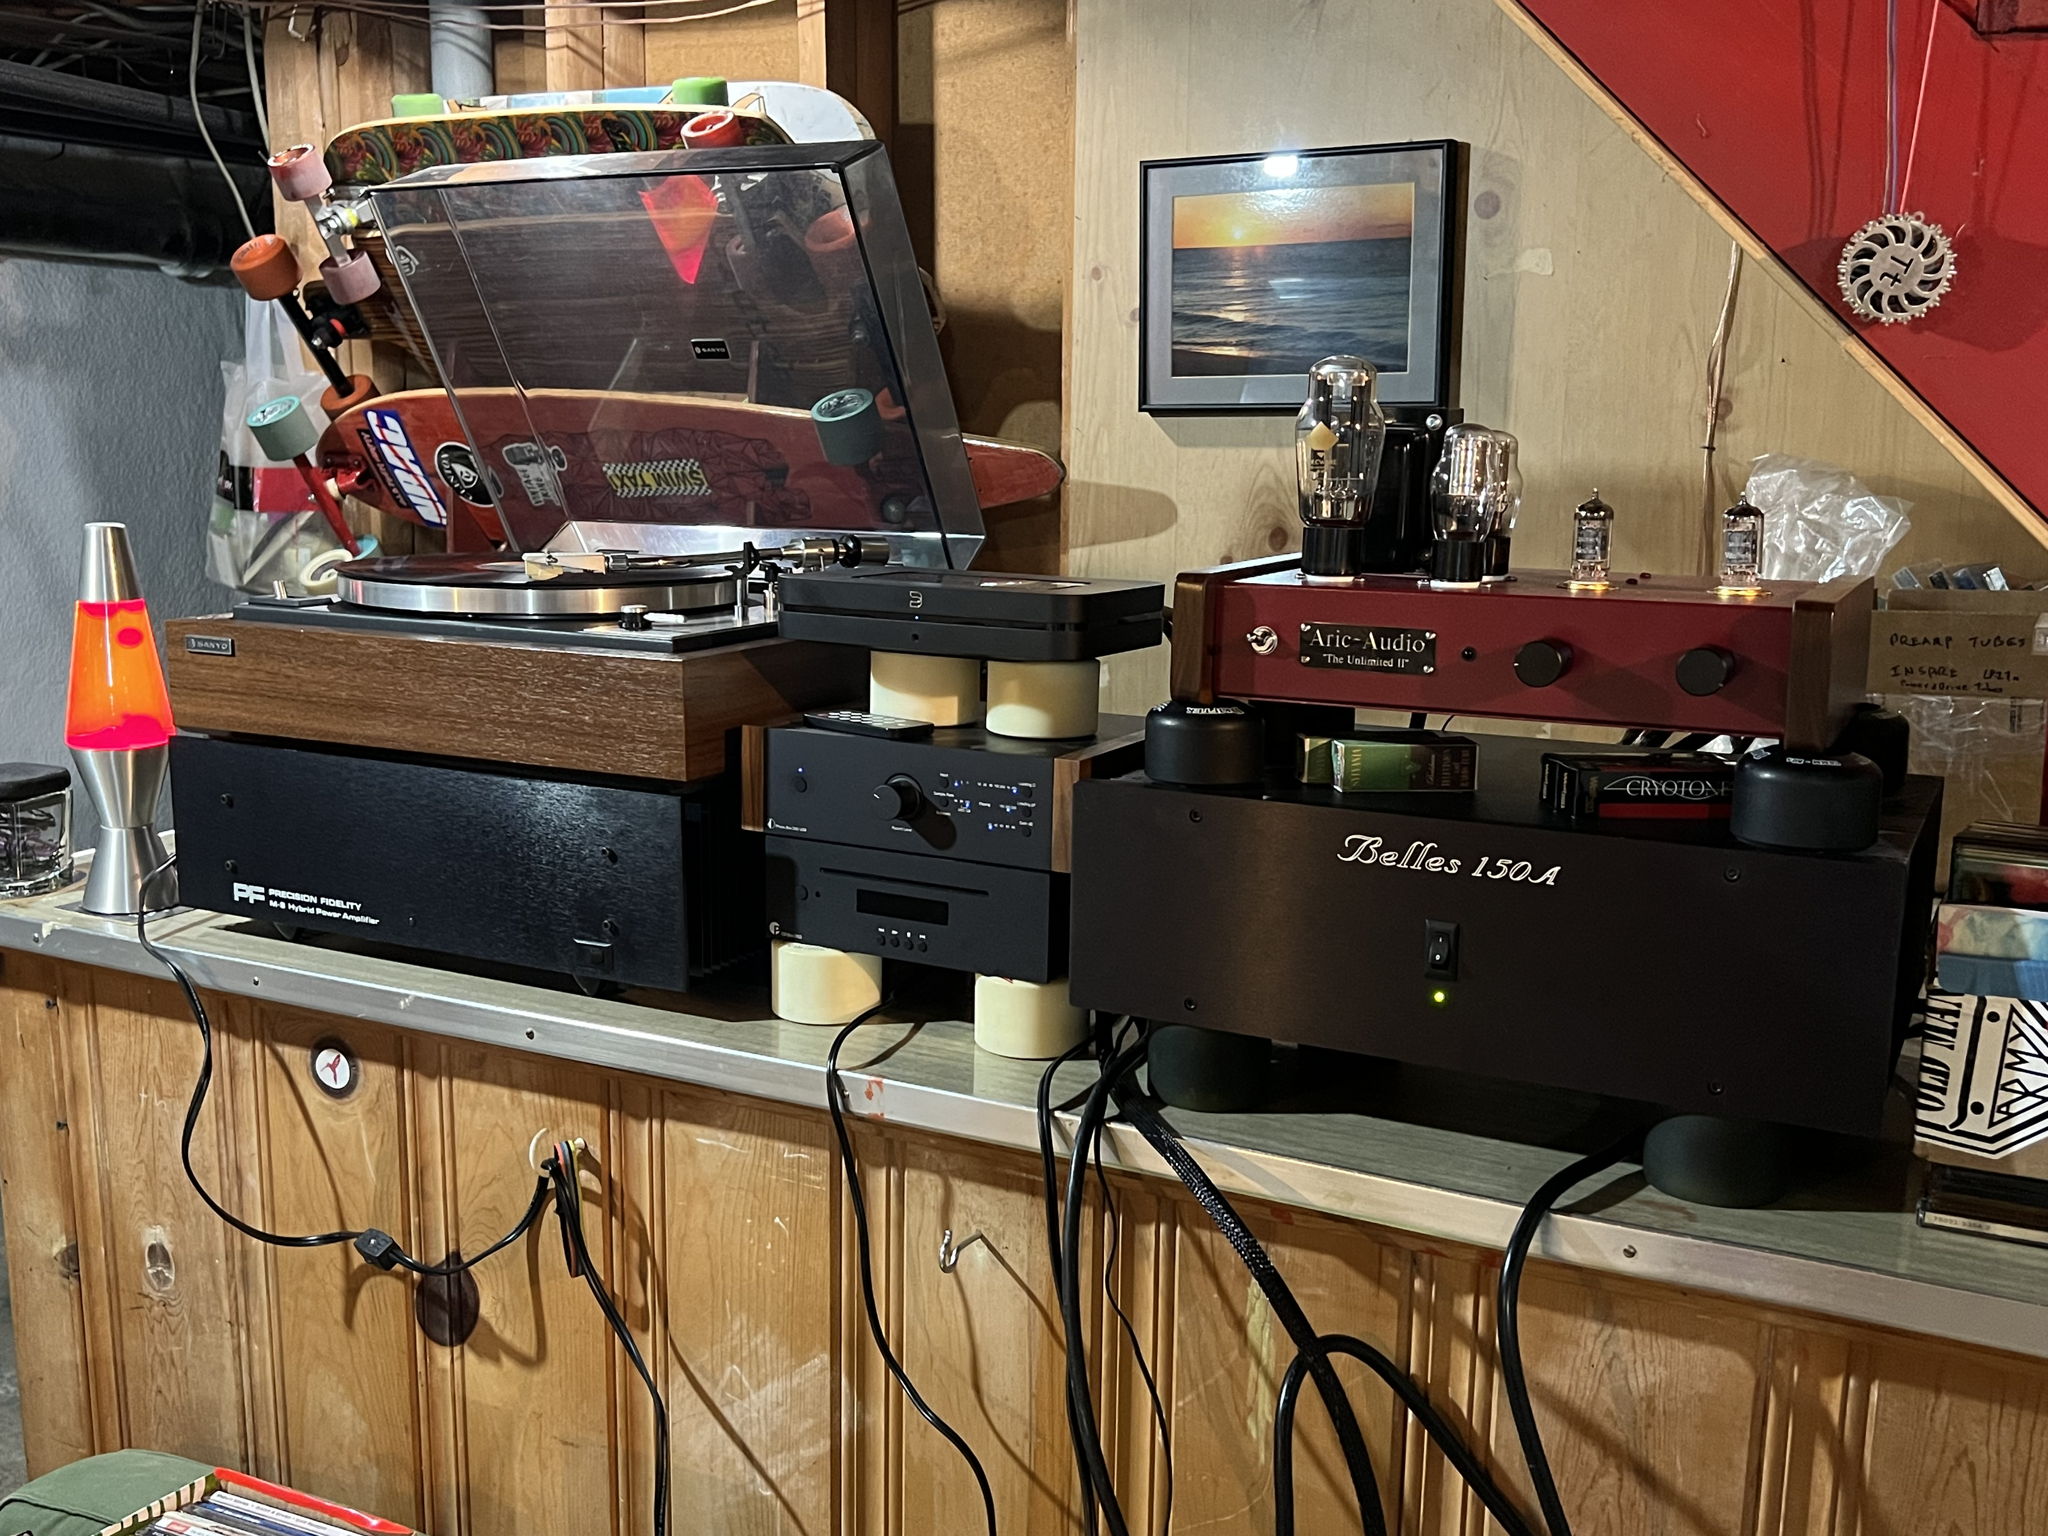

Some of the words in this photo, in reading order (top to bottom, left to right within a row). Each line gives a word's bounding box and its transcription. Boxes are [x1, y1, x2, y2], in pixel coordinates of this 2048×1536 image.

[608, 472, 652, 490] TAXI
[651, 466, 706, 488] SWIM
[197, 641, 228, 650] SANYO
[1968, 635, 2026, 648] TUBES
[1347, 655, 1394, 667] Unlimited
[1351, 749, 1362, 787] SYLVANIA
[1336, 834, 1462, 874] Belles
[1471, 856, 1562, 886] 150A
[268, 888, 318, 904] PRECISION
[320, 897, 362, 911] FIDELITY
[287, 903, 315, 915] Hybrid
[315, 907, 342, 919] Power
[342, 912, 380, 925] Amplifier
[1915, 1055, 1950, 1112] OLD
